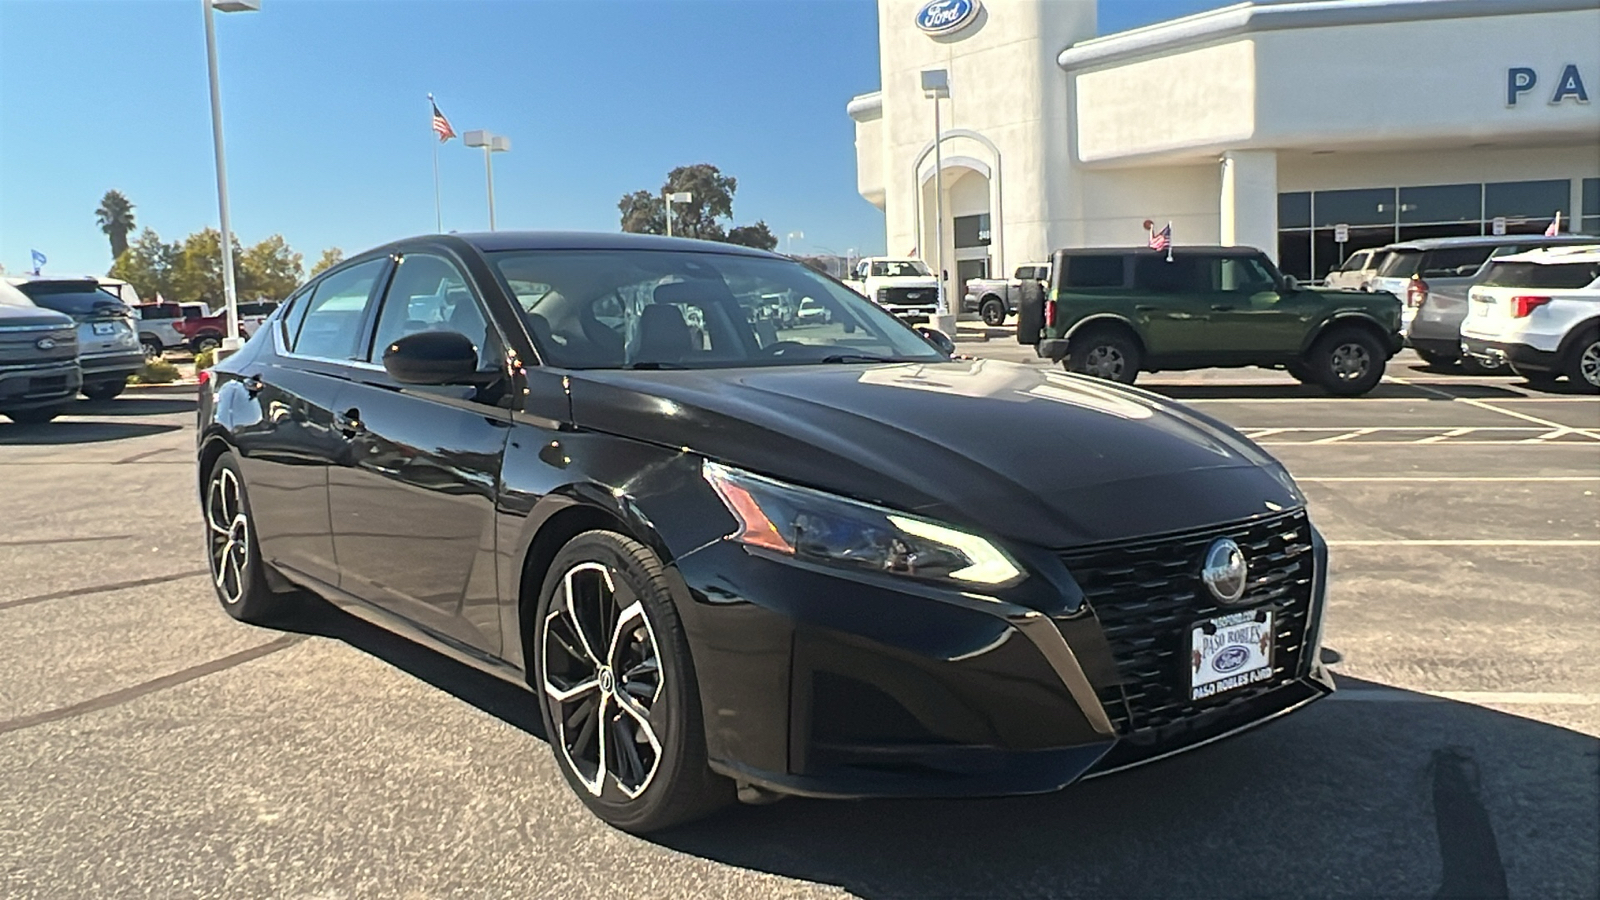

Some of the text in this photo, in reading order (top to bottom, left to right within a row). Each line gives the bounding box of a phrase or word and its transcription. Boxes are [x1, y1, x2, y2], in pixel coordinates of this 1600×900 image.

[924, 0, 960, 27] Ford
[1507, 64, 1590, 106] PA
[1202, 626, 1261, 659] PASO ROBLES
[1192, 685, 1215, 700] PASO
